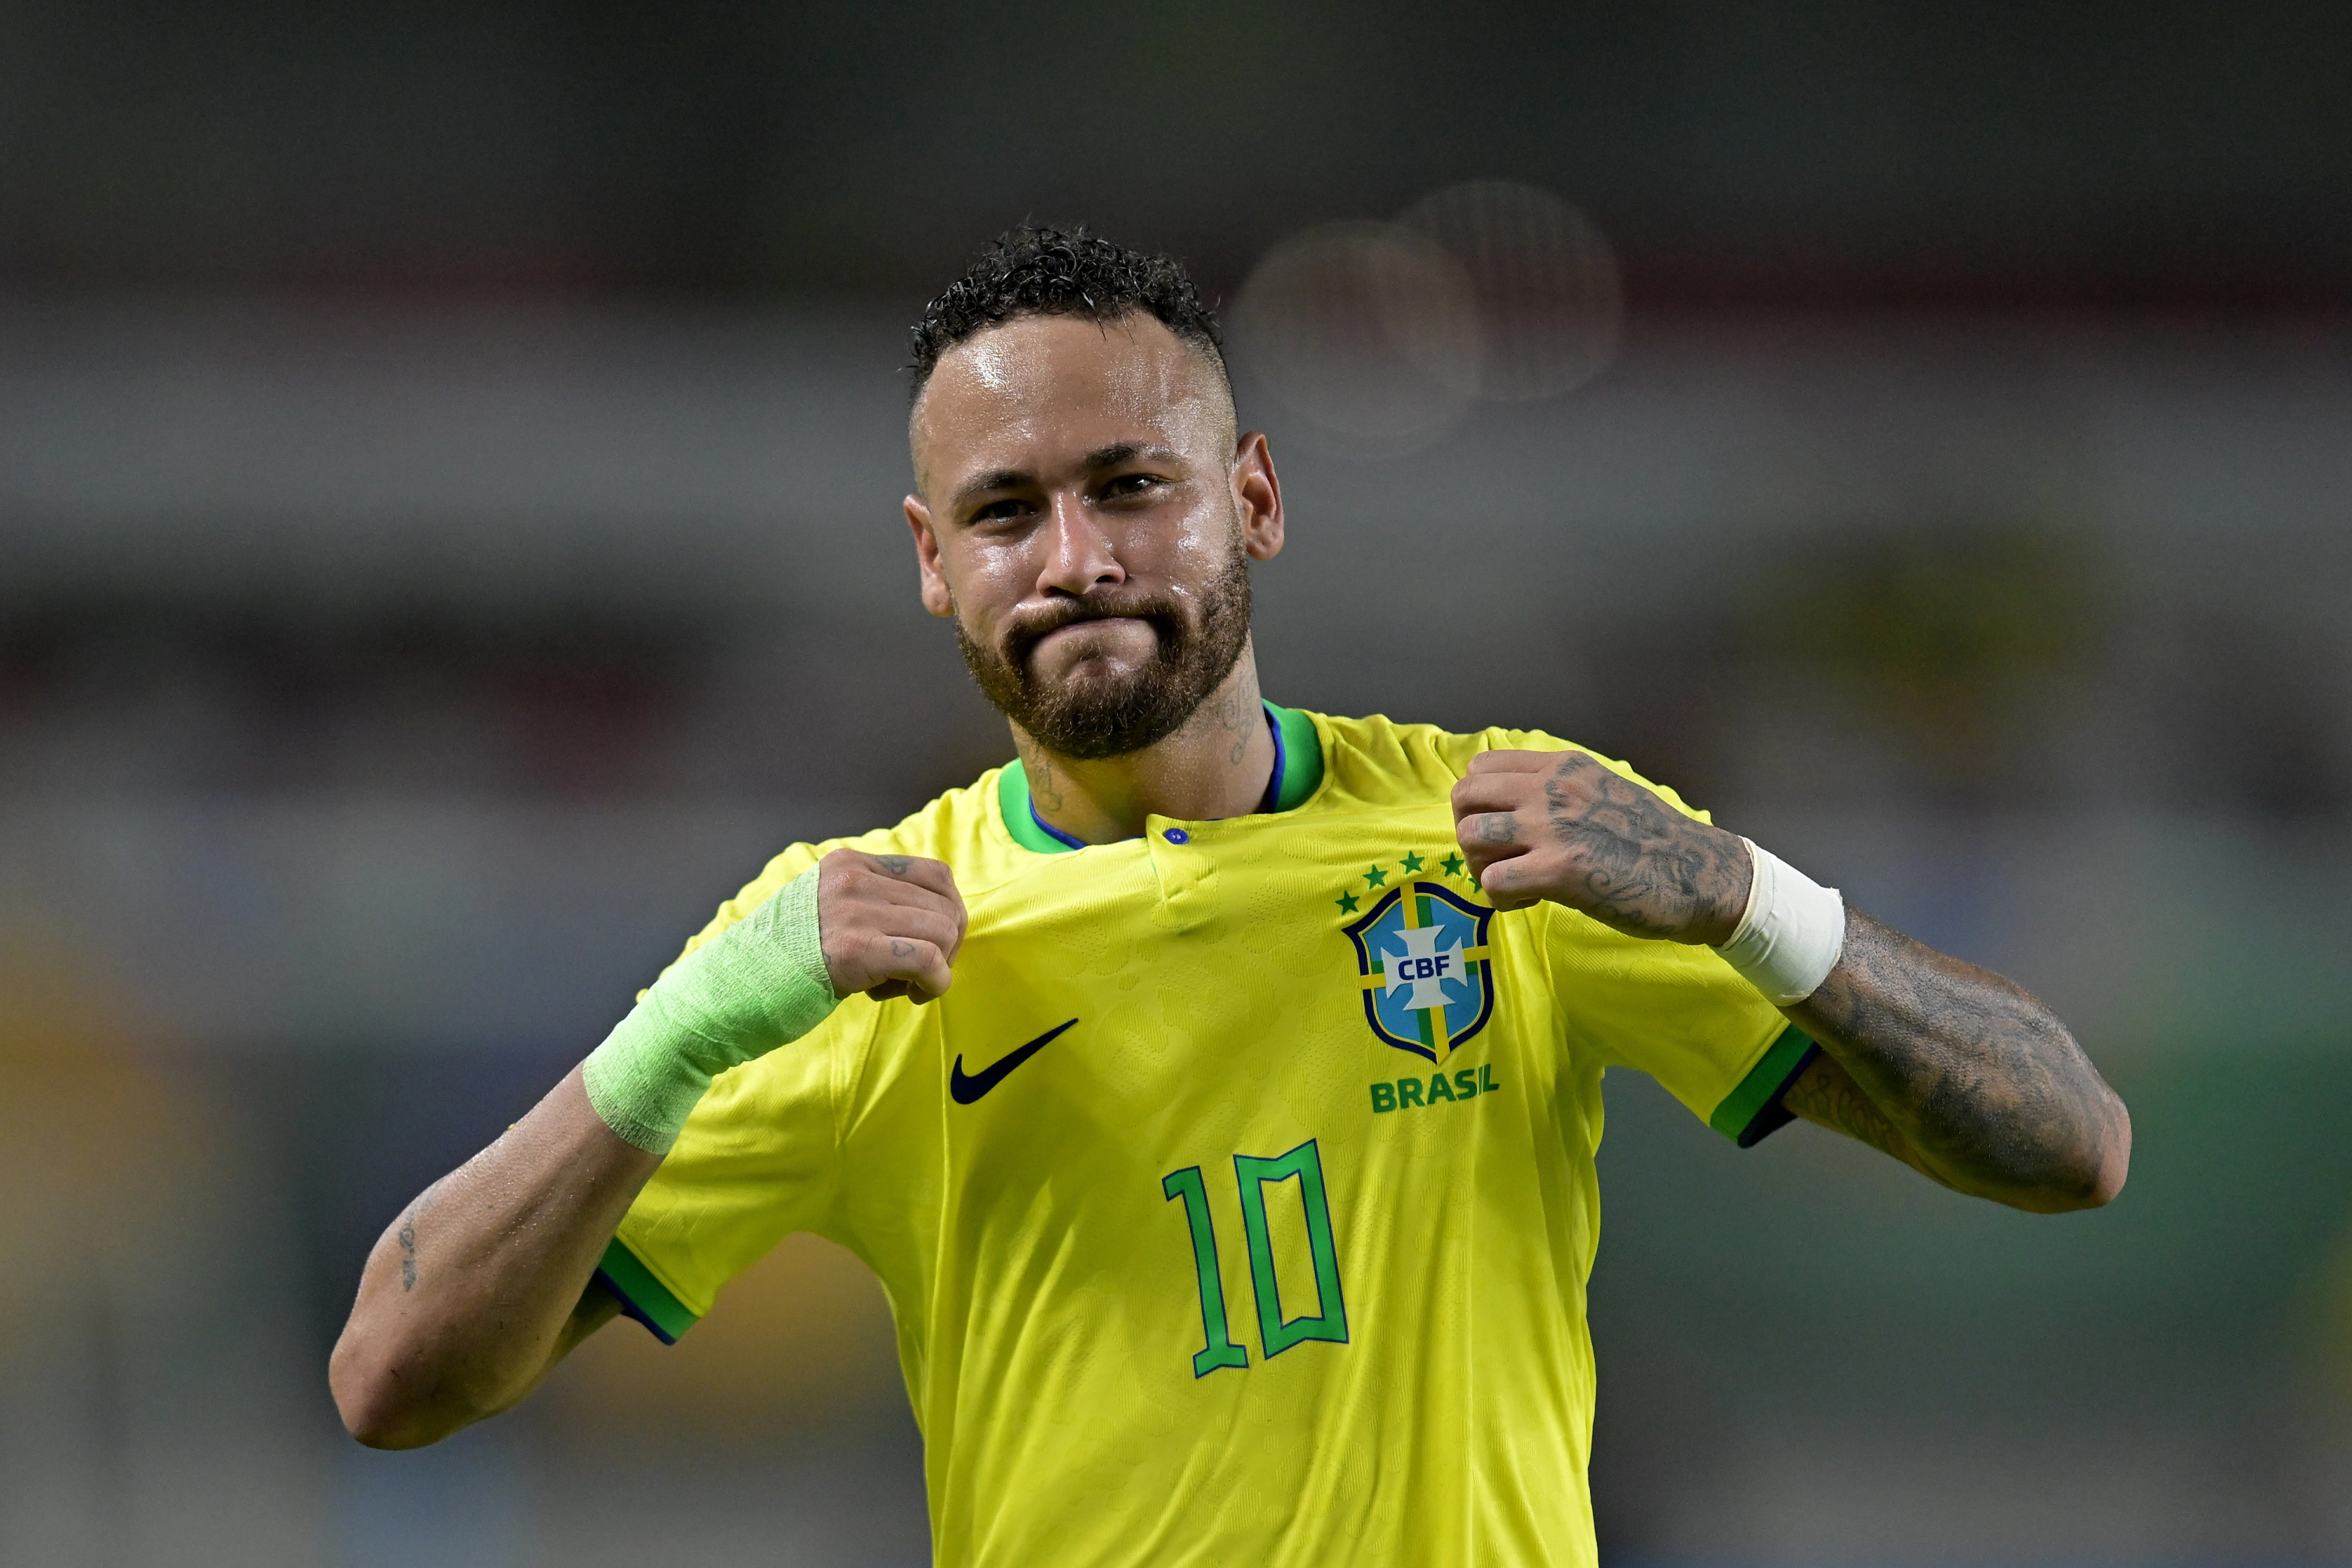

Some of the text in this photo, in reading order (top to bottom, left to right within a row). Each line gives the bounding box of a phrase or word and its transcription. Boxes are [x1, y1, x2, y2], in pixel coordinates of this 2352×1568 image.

[1398, 955, 1450, 981] CBF
[1370, 1064, 1500, 1113] BRASIL
[1162, 1138, 1349, 1379] 10
